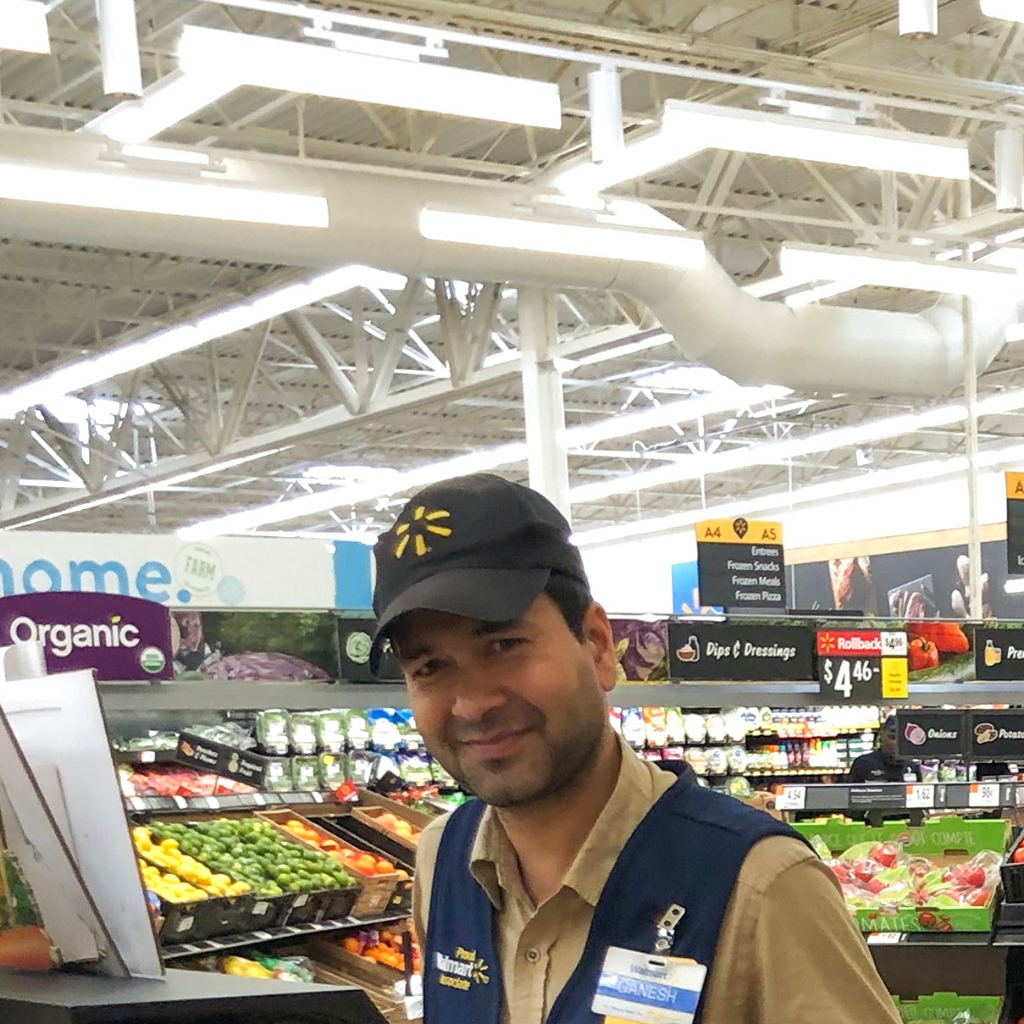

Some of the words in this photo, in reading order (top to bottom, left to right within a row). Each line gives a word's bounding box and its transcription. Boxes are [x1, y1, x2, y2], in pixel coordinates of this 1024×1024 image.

[705, 527, 722, 539] A4
[762, 528, 777, 541] A5
[751, 546, 779, 557] Entrees
[727, 560, 754, 571] Frozen
[754, 561, 780, 572] Snacks
[732, 575, 758, 586] Frozen
[759, 577, 781, 587] Meals
[735, 590, 761, 601] Frozen
[762, 591, 782, 601] Pizza
[10, 616, 140, 657] Organic
[706, 641, 730, 658] Dips
[733, 640, 741, 660] &
[743, 642, 796, 661] Dressings
[928, 728, 958, 739] Onions
[630, 963, 668, 980] Walmart
[617, 980, 678, 1004] GANESH
